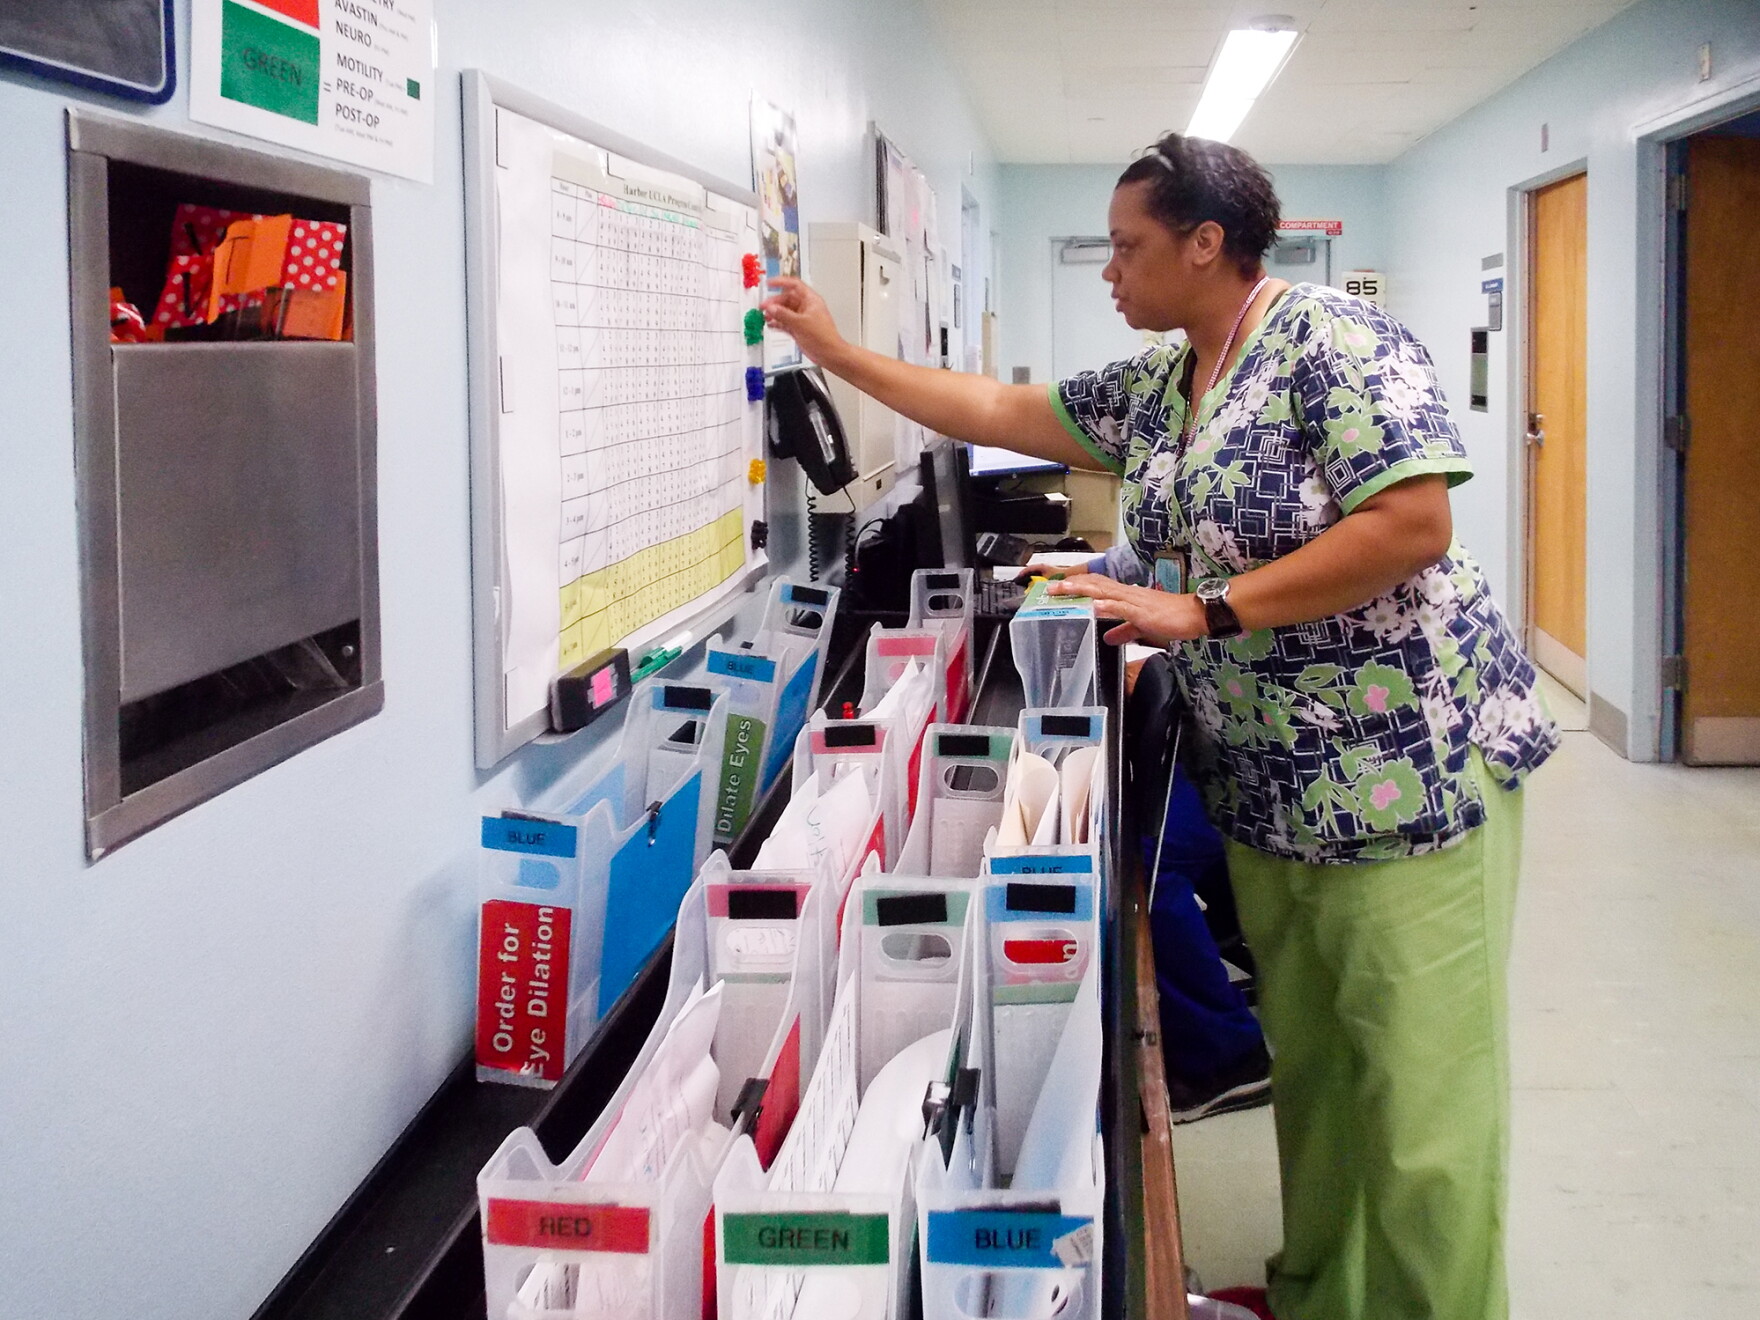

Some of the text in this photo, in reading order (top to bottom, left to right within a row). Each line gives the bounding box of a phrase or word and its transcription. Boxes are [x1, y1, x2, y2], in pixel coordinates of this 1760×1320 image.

[335, 0, 378, 27] AVASTIN
[336, 20, 372, 48] NEURO
[243, 47, 302, 86] GREEN
[336, 53, 384, 83] MOTILITY
[336, 77, 374, 103] PRE-OP
[335, 102, 381, 129] POST-OP
[1280, 221, 1339, 230] COMPARTMENT
[1345, 280, 1378, 296] 85
[727, 660, 754, 675] BLUE
[717, 720, 752, 833] Dilate Eyes
[507, 830, 546, 846] BLUE
[492, 922, 520, 1053] Order for
[519, 906, 554, 1078] Eye Dilation
[538, 1215, 592, 1238] RED
[757, 1225, 851, 1251] GREEN
[974, 1227, 1042, 1251] BLUE
